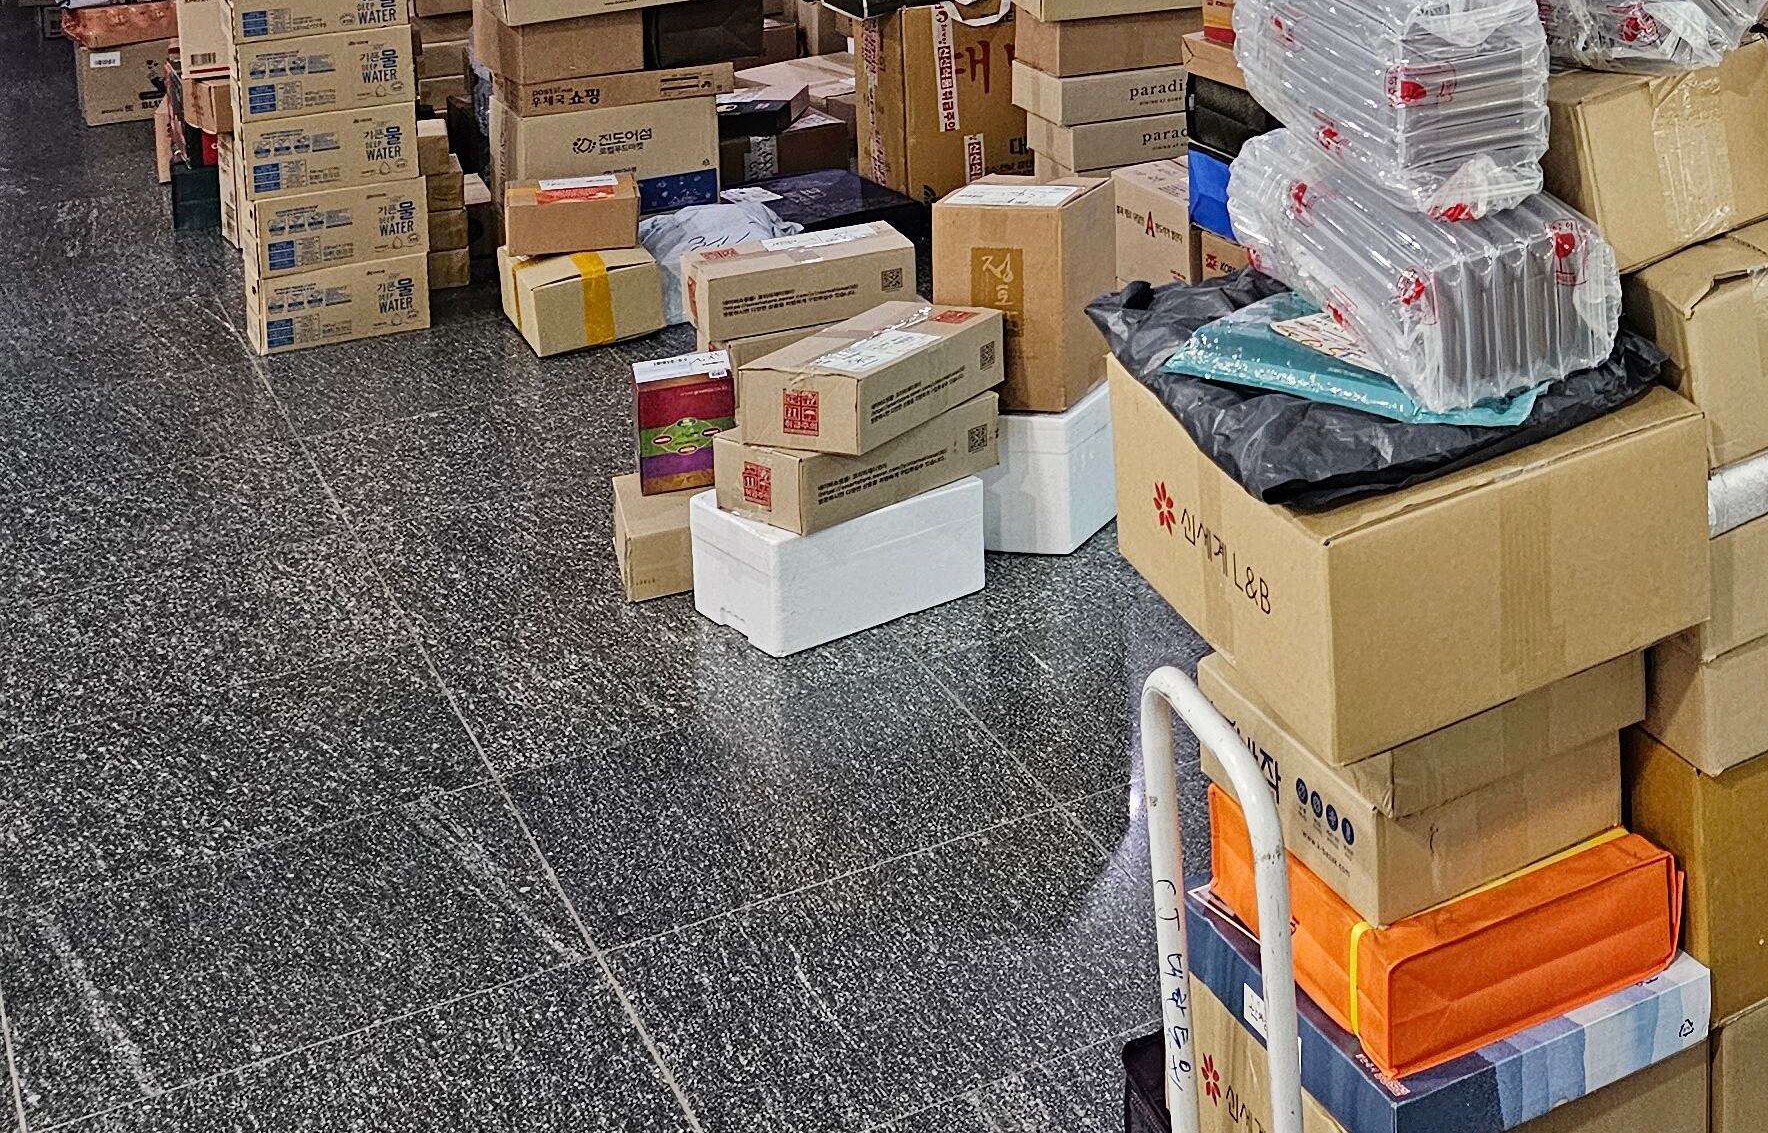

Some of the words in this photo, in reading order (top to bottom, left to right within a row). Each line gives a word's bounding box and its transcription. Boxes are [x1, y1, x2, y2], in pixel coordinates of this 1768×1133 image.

[357, 8, 397, 25] WATER
[379, 48, 399, 69] 물
[361, 68, 398, 85] WATER
[531, 95, 565, 108] 우체국
[569, 87, 601, 106] 쇼핑
[383, 125, 403, 146] 물
[598, 127, 653, 147] 진도어섬
[365, 145, 403, 162] WATER
[396, 200, 417, 221] 물
[379, 221, 415, 237] WATER
[1145, 210, 1156, 239] A
[395, 277, 415, 297] 물
[377, 297, 413, 315] WATER
[1181, 507, 1229, 578] 신세계
[1232, 551, 1271, 615] L&B
